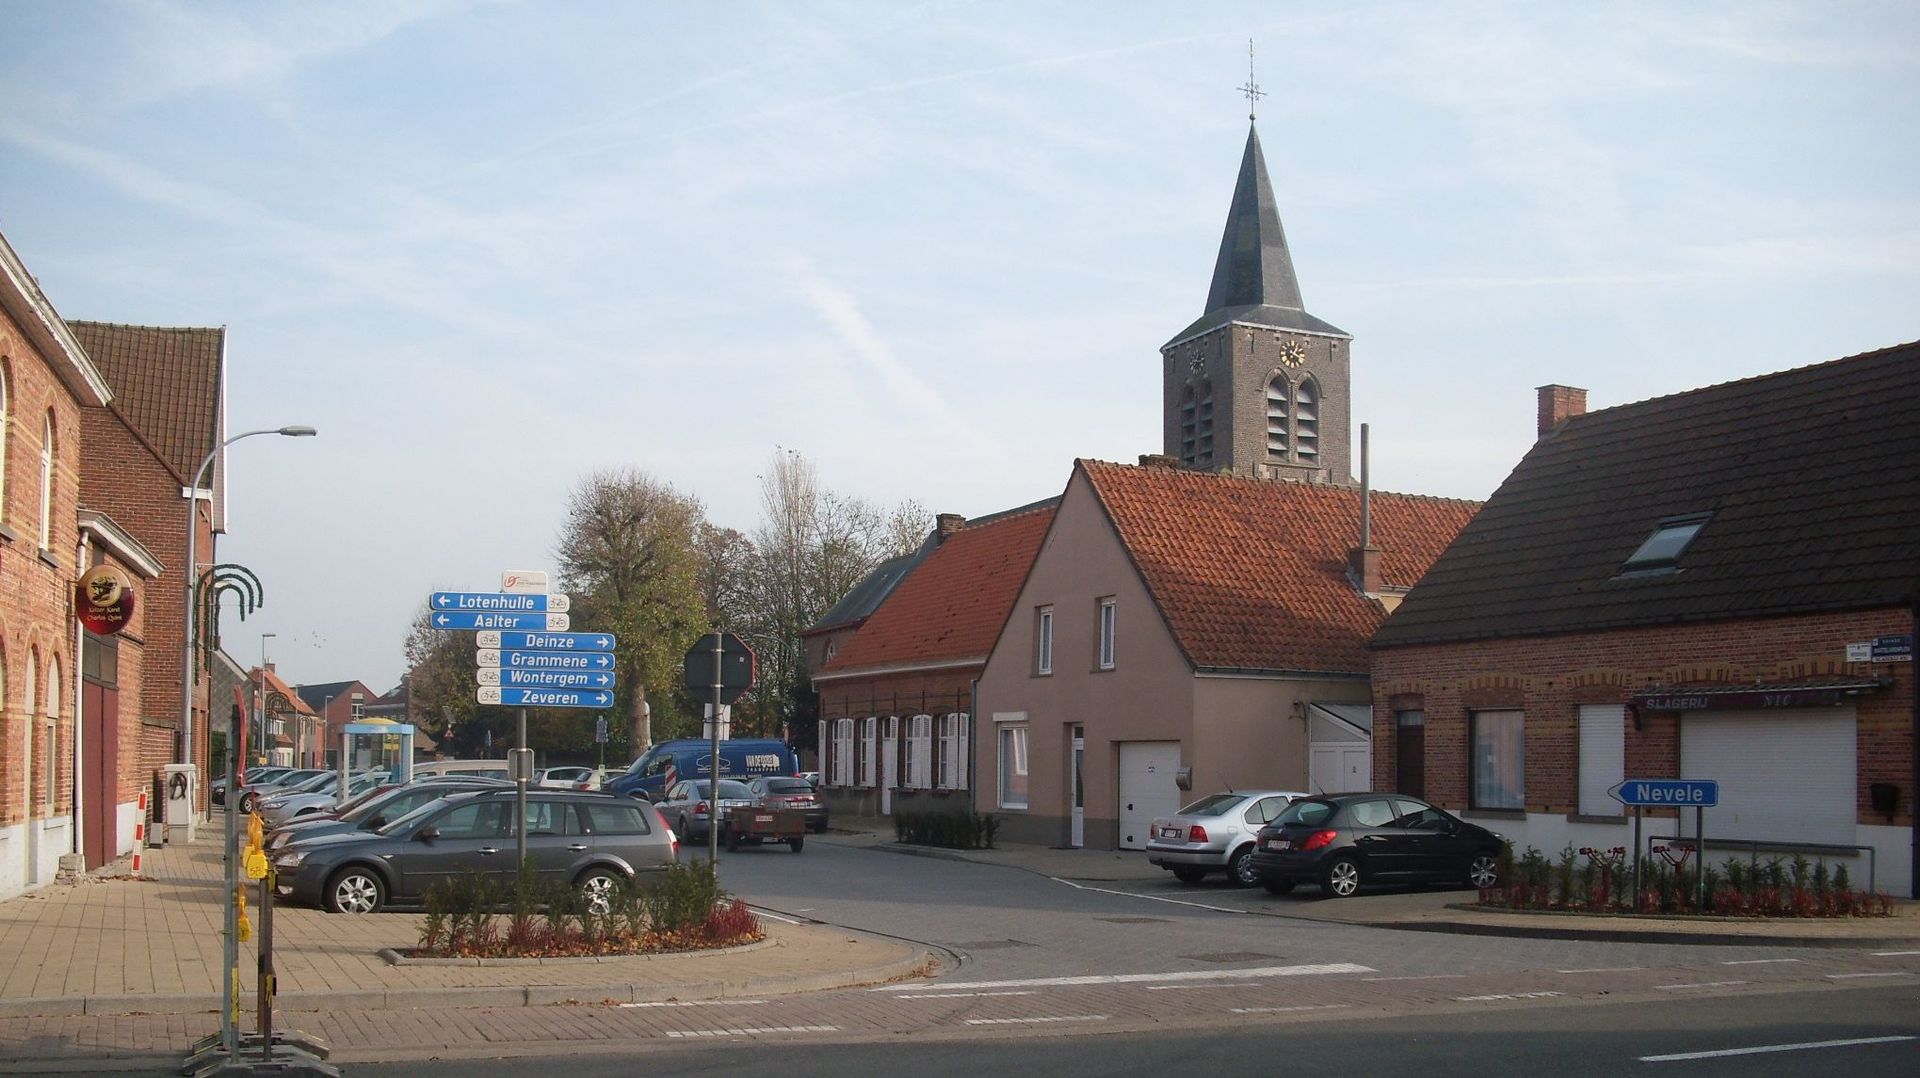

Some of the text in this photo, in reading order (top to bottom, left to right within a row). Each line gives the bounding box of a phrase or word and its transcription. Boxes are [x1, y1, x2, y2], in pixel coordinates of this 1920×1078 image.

[459, 594, 534, 609] Lotenhulle
[474, 614, 519, 628] Aalter
[526, 634, 575, 648] Deinze
[511, 653, 588, 668] Grammene
[511, 671, 588, 687] Wontergem
[521, 690, 578, 705] Zeveren
[1646, 697, 1708, 710] SLAGERIJ
[1637, 783, 1703, 802] Nevele
